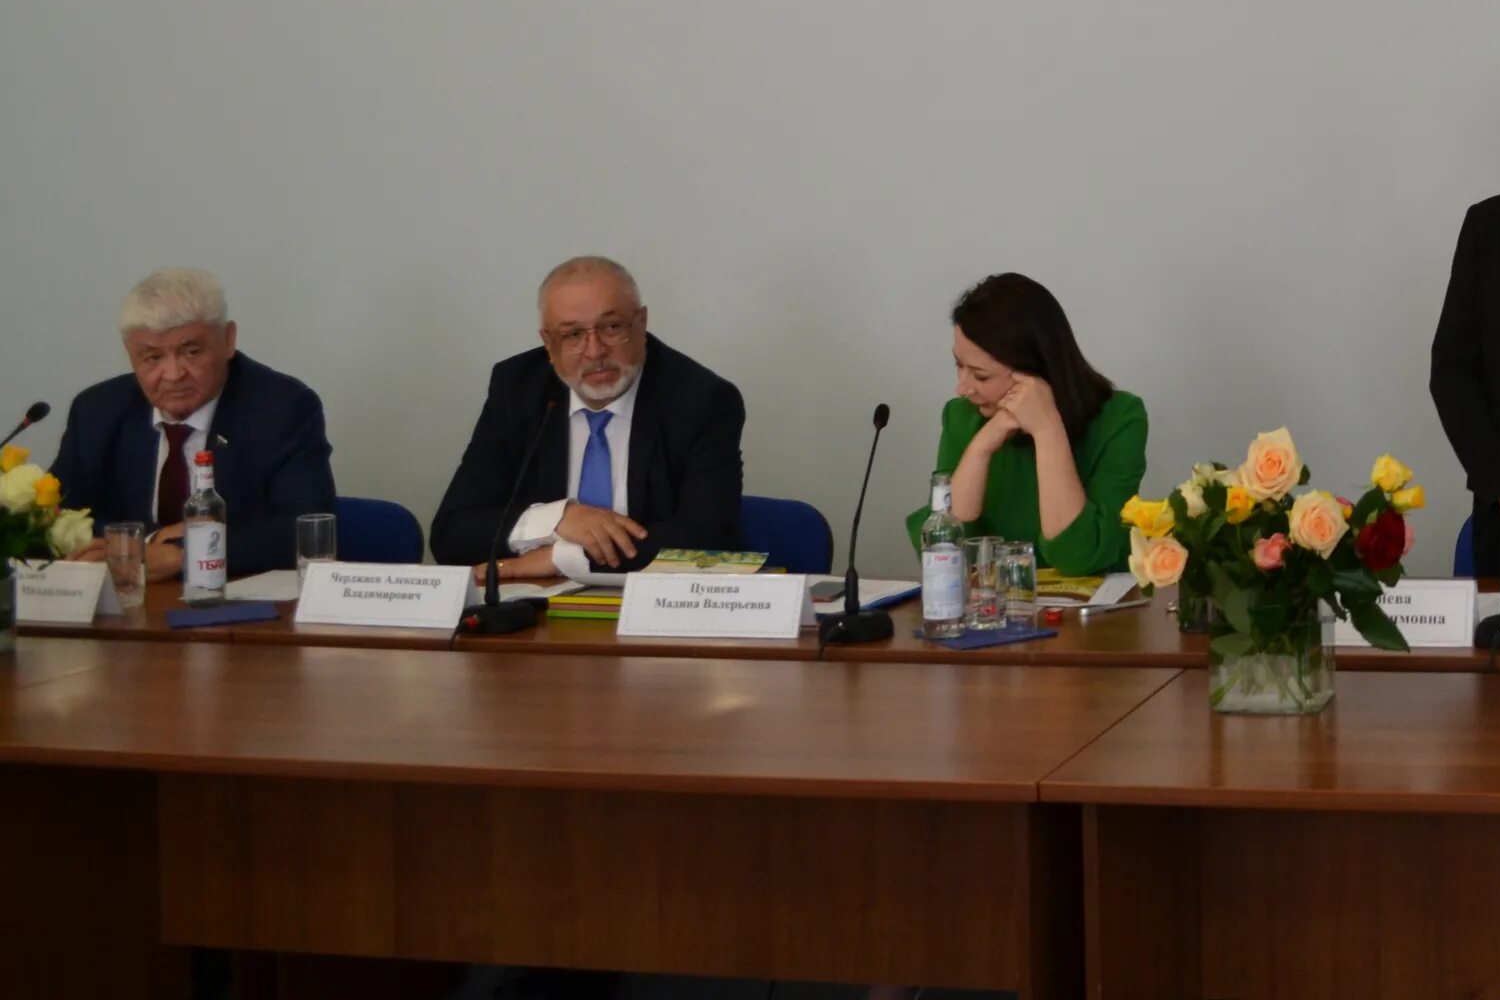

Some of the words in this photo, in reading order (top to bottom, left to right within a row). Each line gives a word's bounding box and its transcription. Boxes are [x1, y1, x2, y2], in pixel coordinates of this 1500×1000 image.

[384, 575, 441, 589] Александр
[342, 587, 422, 602] Владимирович
[654, 598, 700, 609] Мадина
[702, 598, 772, 612] Валерьевна
